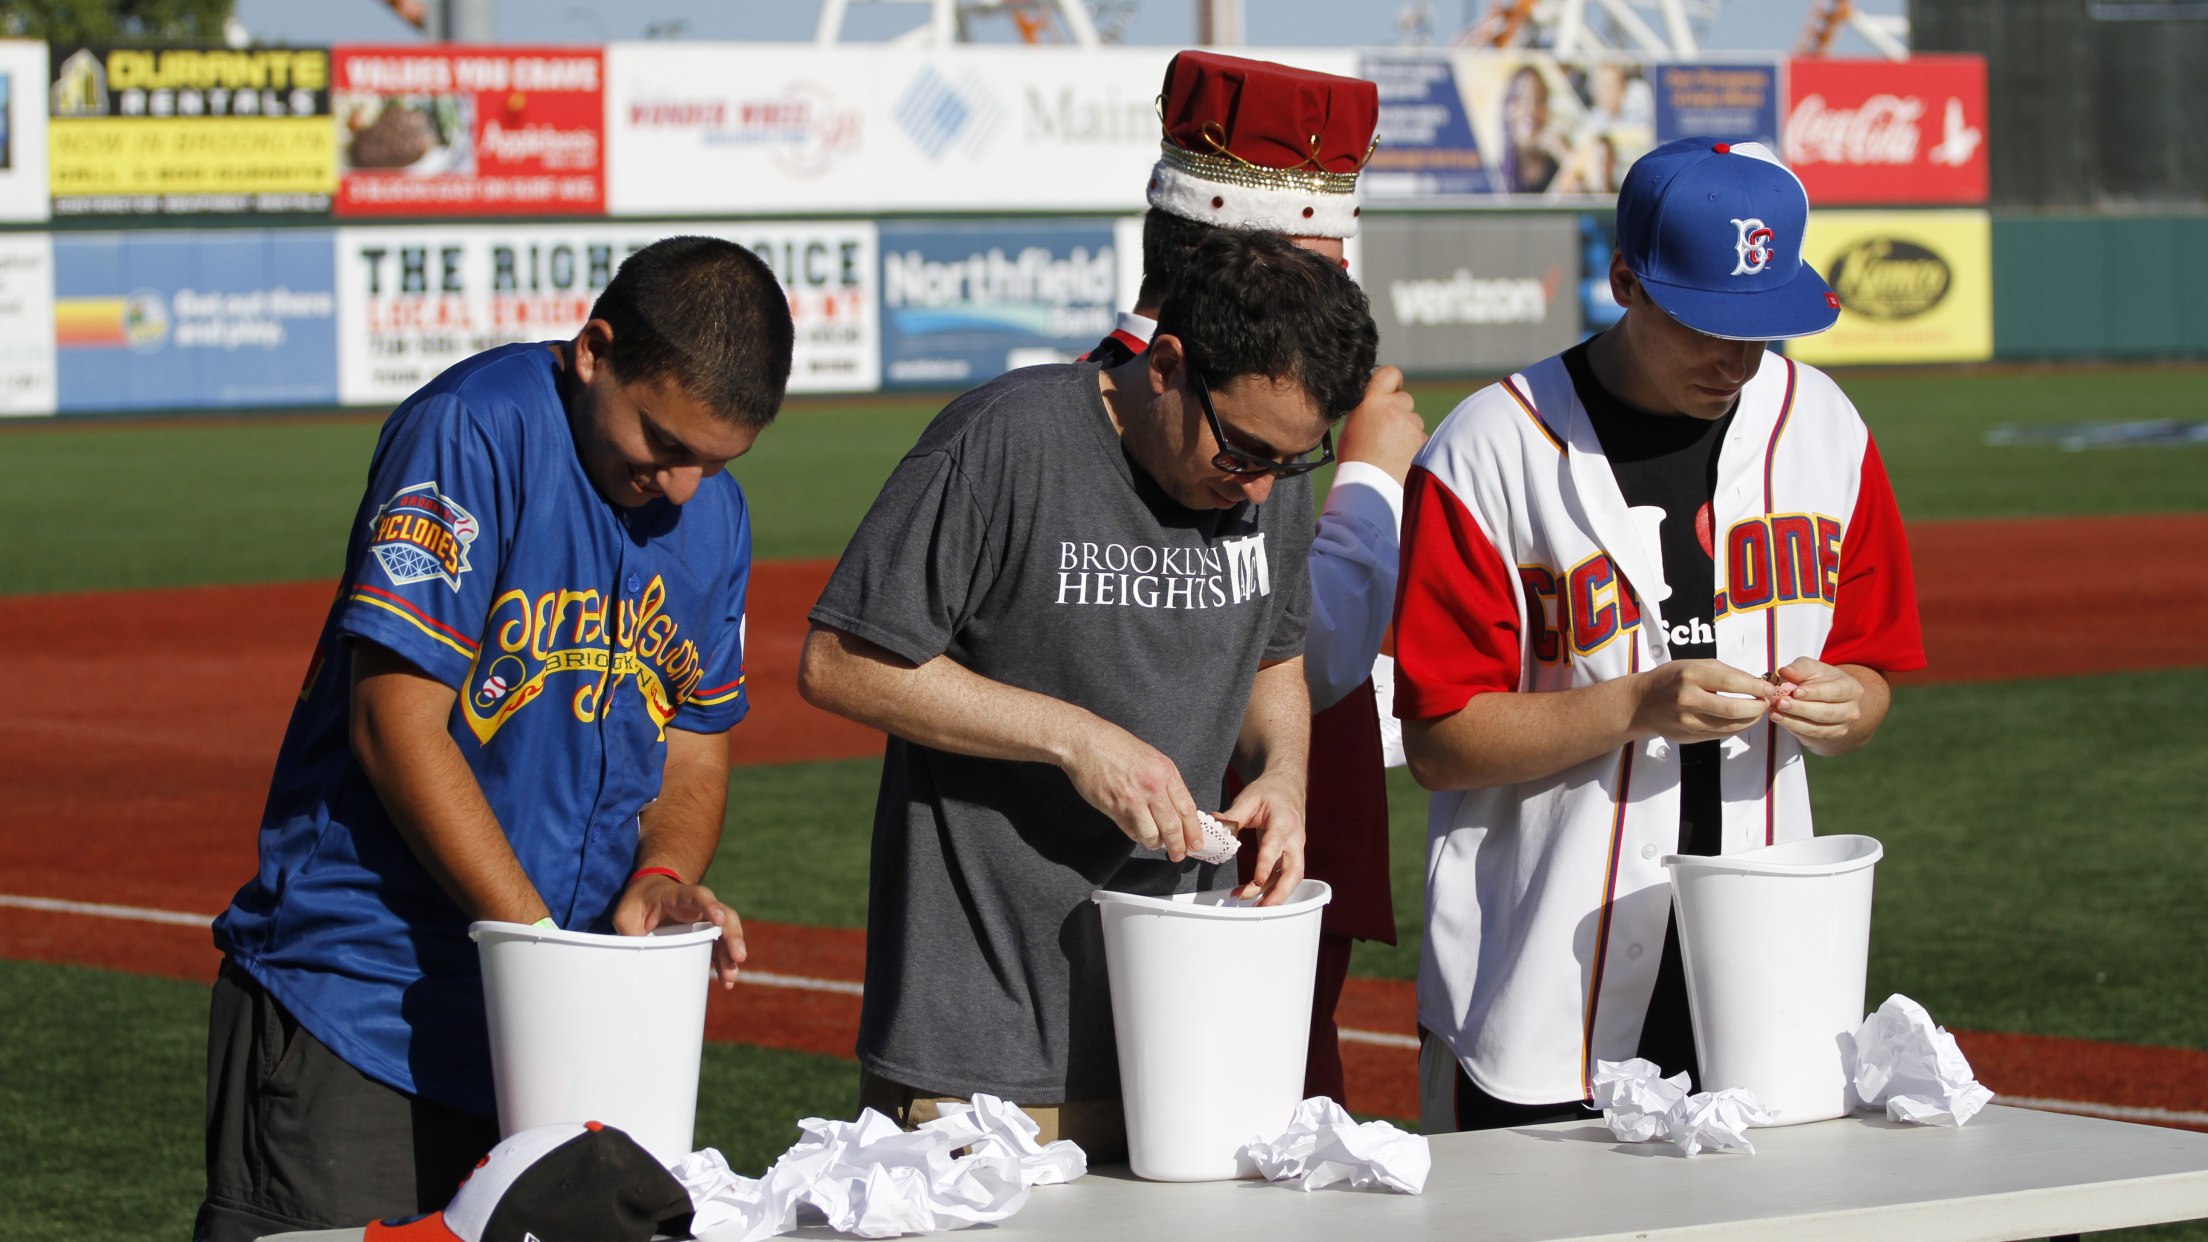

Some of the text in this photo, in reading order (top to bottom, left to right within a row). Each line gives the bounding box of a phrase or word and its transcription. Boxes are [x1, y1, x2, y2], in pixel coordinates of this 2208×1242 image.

[107, 50, 329, 90] DURANTE
[346, 56, 452, 92] VALUES
[455, 56, 509, 91] YOU
[513, 57, 600, 91] CRAVE
[120, 88, 317, 116] RENTALS
[1784, 93, 1928, 166] Coca-Cola
[360, 245, 464, 294] THE
[491, 243, 636, 291] RIGH
[884, 245, 1115, 308] Northfield
[172, 288, 221, 319] Get
[268, 286, 332, 318] there
[1390, 267, 1546, 325] verizon
[173, 321, 222, 347] and
[367, 298, 473, 334] LOCAL
[374, 514, 459, 575] YCLONES
[1058, 541, 1223, 575] BROOKLYN
[1055, 572, 1227, 610] HEIGHTS
